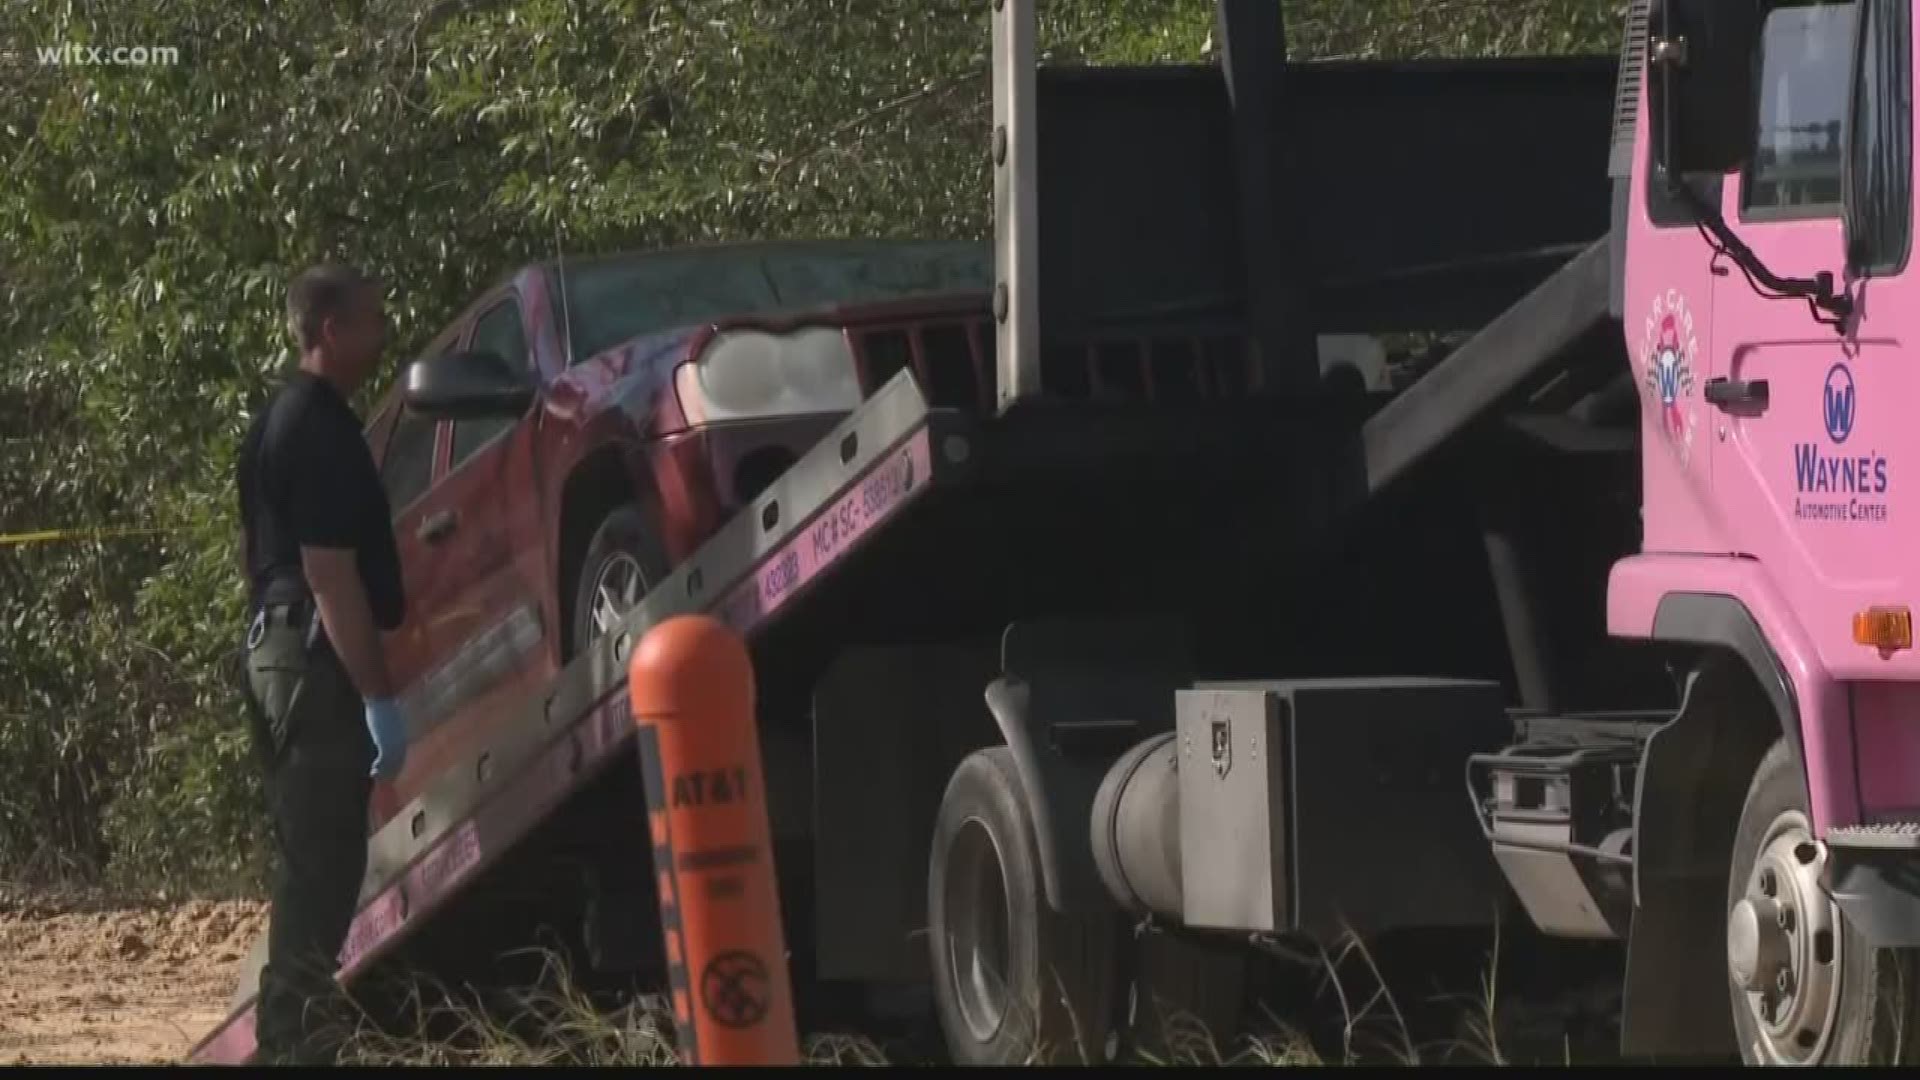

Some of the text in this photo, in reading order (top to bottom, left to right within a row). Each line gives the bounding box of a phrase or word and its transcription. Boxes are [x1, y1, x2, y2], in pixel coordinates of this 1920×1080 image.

[1825, 384, 1853, 433] W
[1849, 498, 1887, 520] CENTER
[673, 769, 748, 808] AT&T
